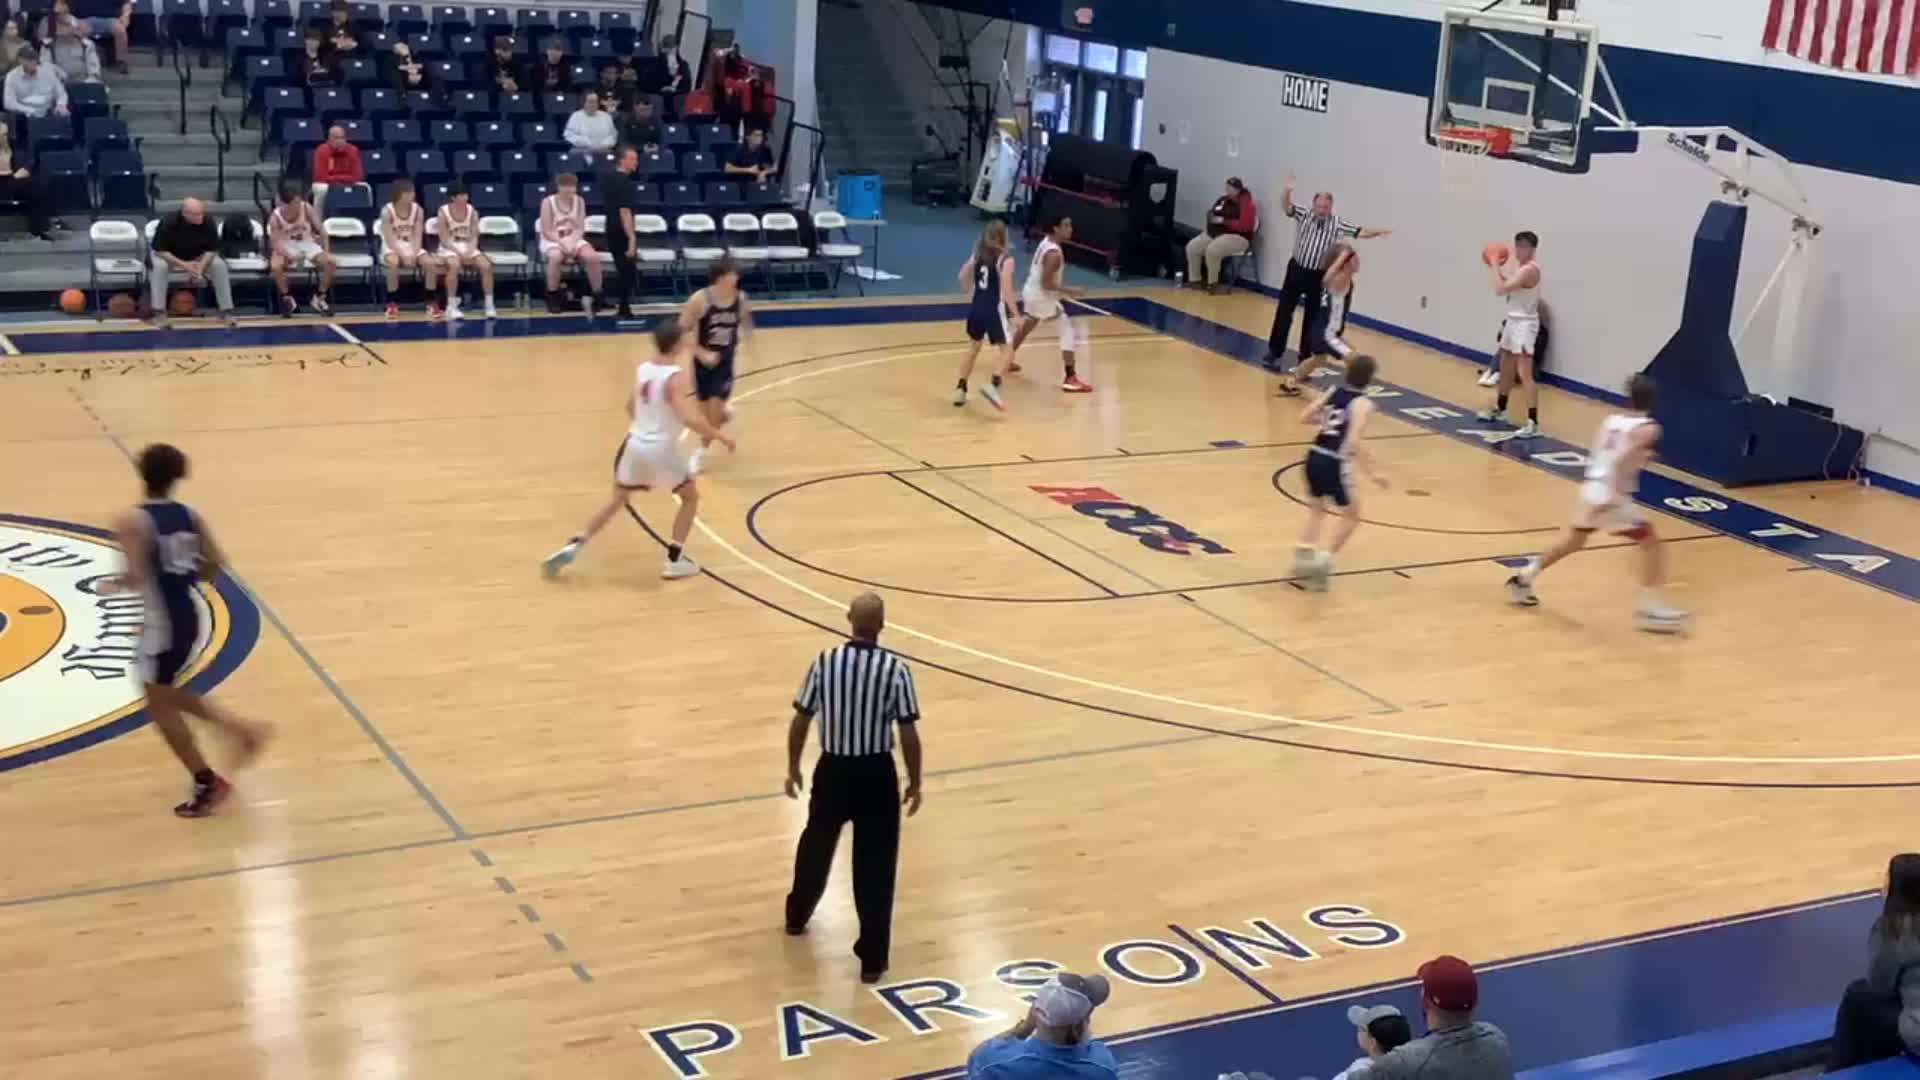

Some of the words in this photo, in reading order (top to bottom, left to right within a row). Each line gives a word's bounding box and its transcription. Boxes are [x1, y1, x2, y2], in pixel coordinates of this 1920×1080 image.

[1283, 76, 1328, 111] HOME
[1666, 132, 1710, 162] Schelde
[979, 265, 990, 290] 3
[638, 903, 1406, 1079] PARSONS
